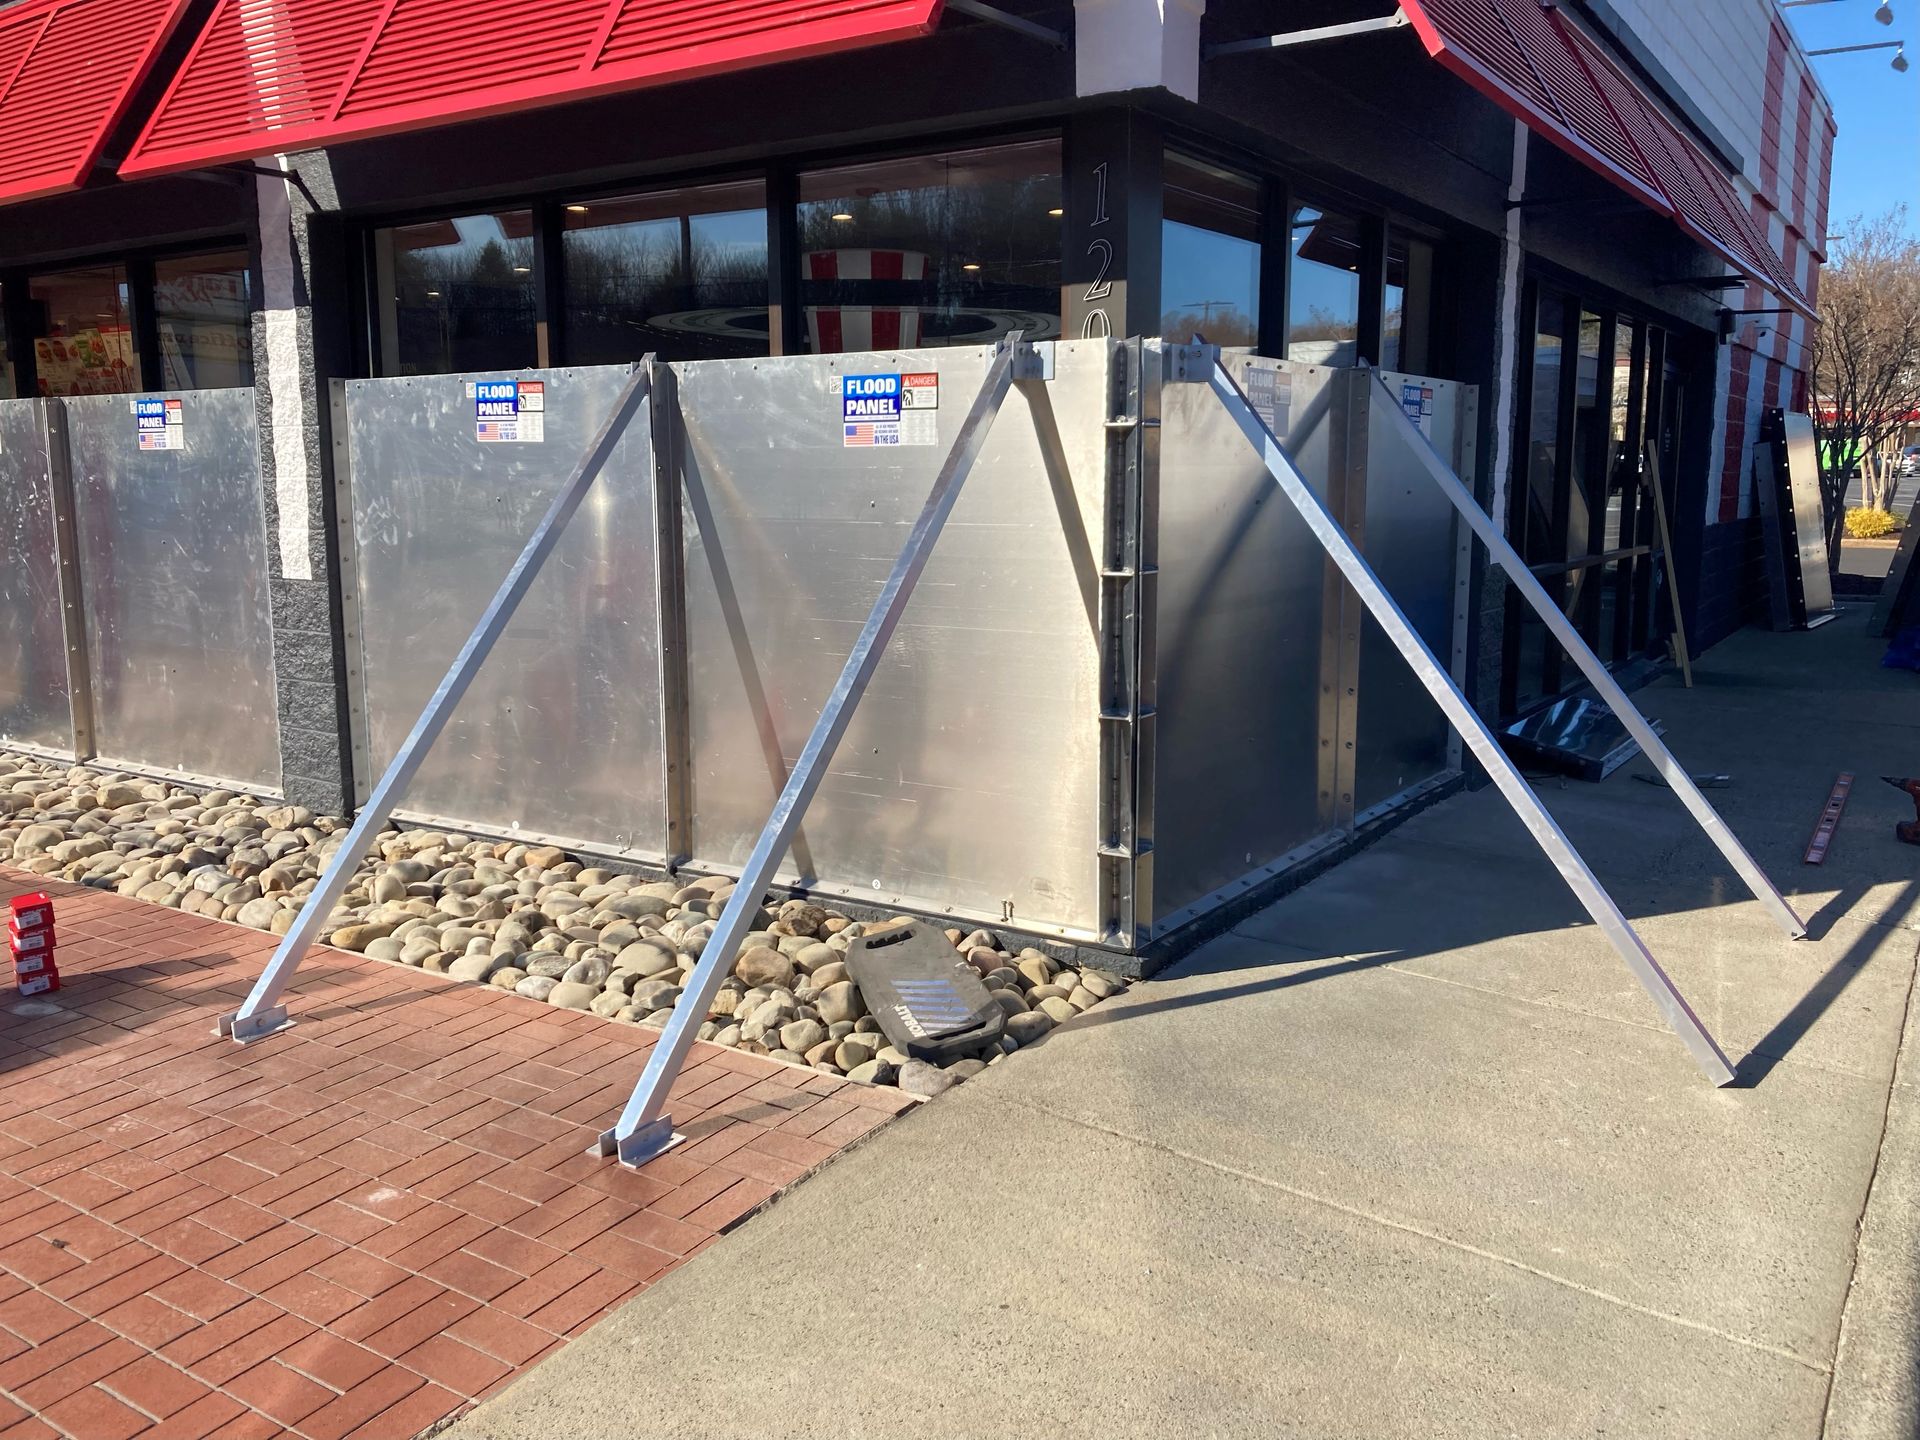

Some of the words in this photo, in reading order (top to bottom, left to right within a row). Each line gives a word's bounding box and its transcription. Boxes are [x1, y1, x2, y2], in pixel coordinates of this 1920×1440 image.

[847, 378, 896, 394] FLOOD
[910, 376, 936, 385] DANGER
[1250, 372, 1273, 387] FLOOD
[478, 385, 514, 398] FLOOD
[1249, 391, 1273, 407] PANEL
[138, 403, 162, 413] FLOOD
[478, 402, 515, 415] PANEL
[846, 399, 897, 415] PANEL
[139, 417, 164, 427] PANEL
[874, 435, 879, 444] IN
[880, 435, 888, 444] THE
[889, 435, 899, 444] USA
[893, 1003, 927, 1038] KOBALT
